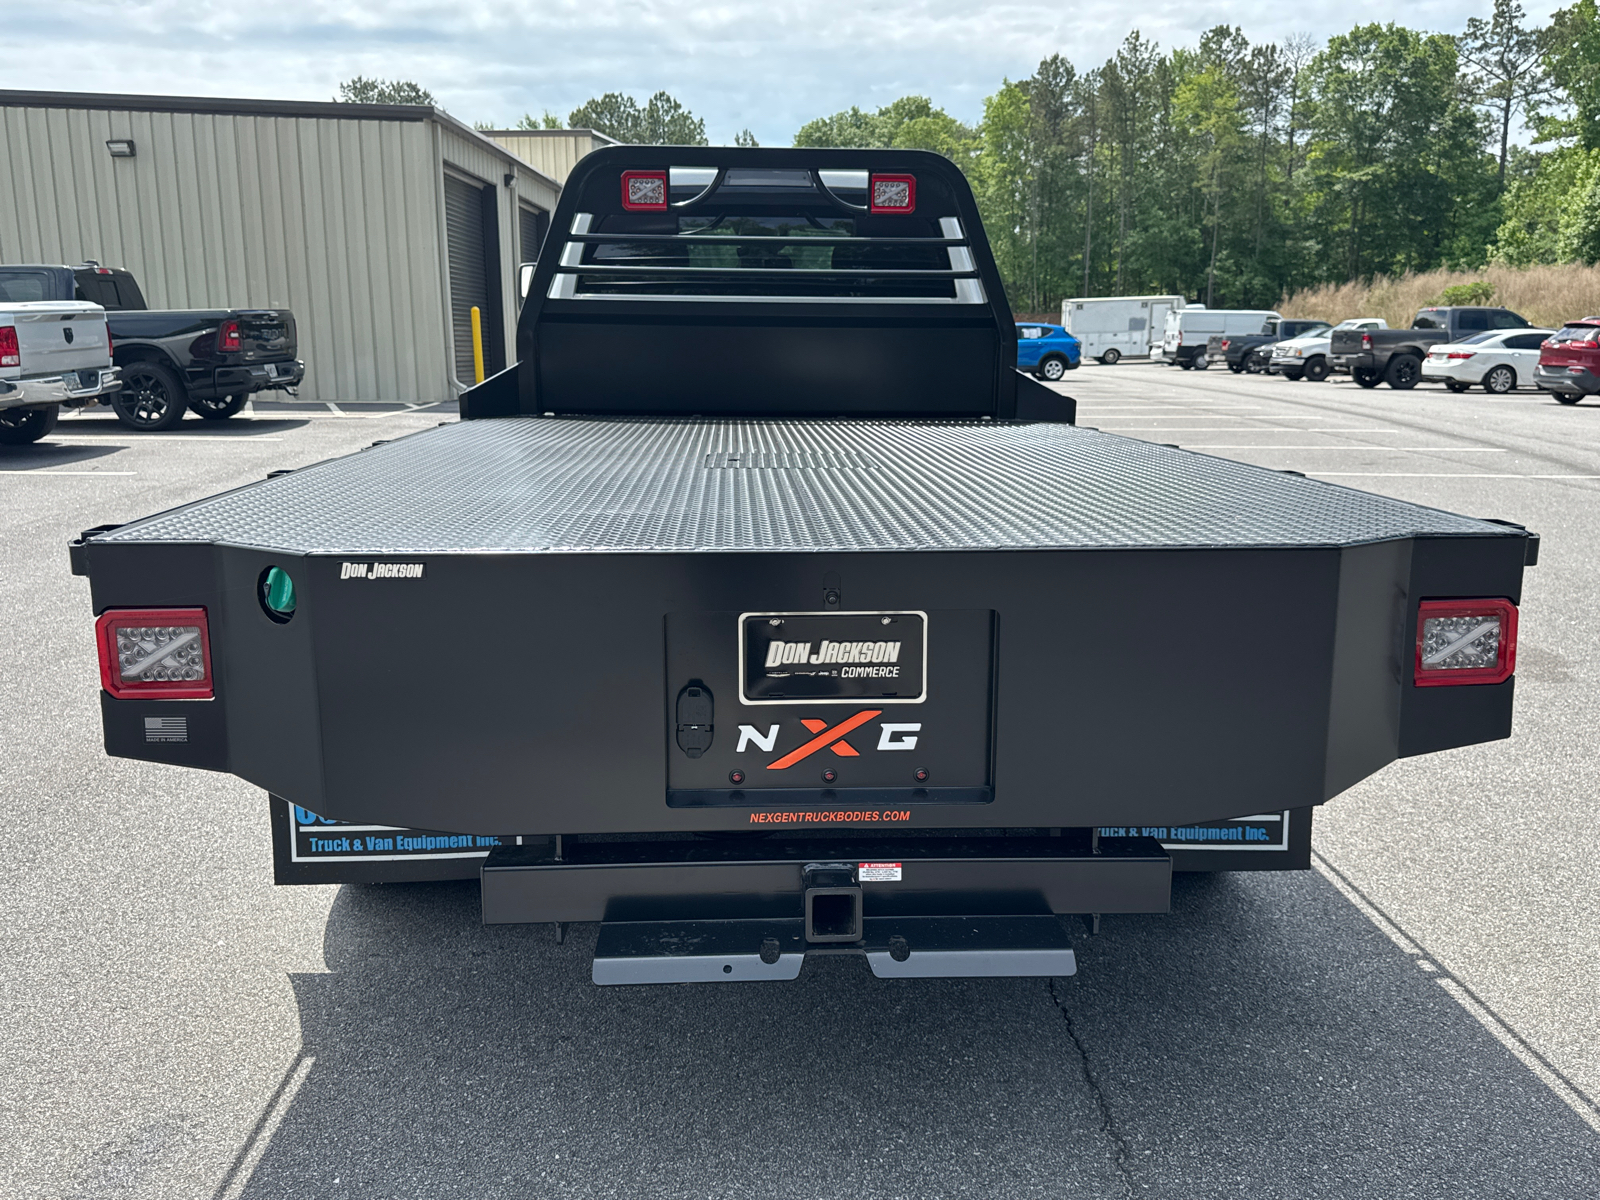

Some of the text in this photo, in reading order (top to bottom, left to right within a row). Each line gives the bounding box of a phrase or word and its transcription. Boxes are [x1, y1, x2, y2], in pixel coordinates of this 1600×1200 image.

[340, 562, 424, 580] DON JACKSON
[764, 640, 901, 668] DON JACKSON
[841, 666, 900, 678] COMMERCE
[750, 810, 911, 824] NEXGENTRUCKBODIES.COM
[1170, 826, 1244, 841] Equipment
[1245, 826, 1270, 841] Inc.
[309, 837, 351, 852] Truck
[352, 838, 364, 852] &
[365, 836, 394, 851] Van
[396, 835, 474, 852] Equipment
